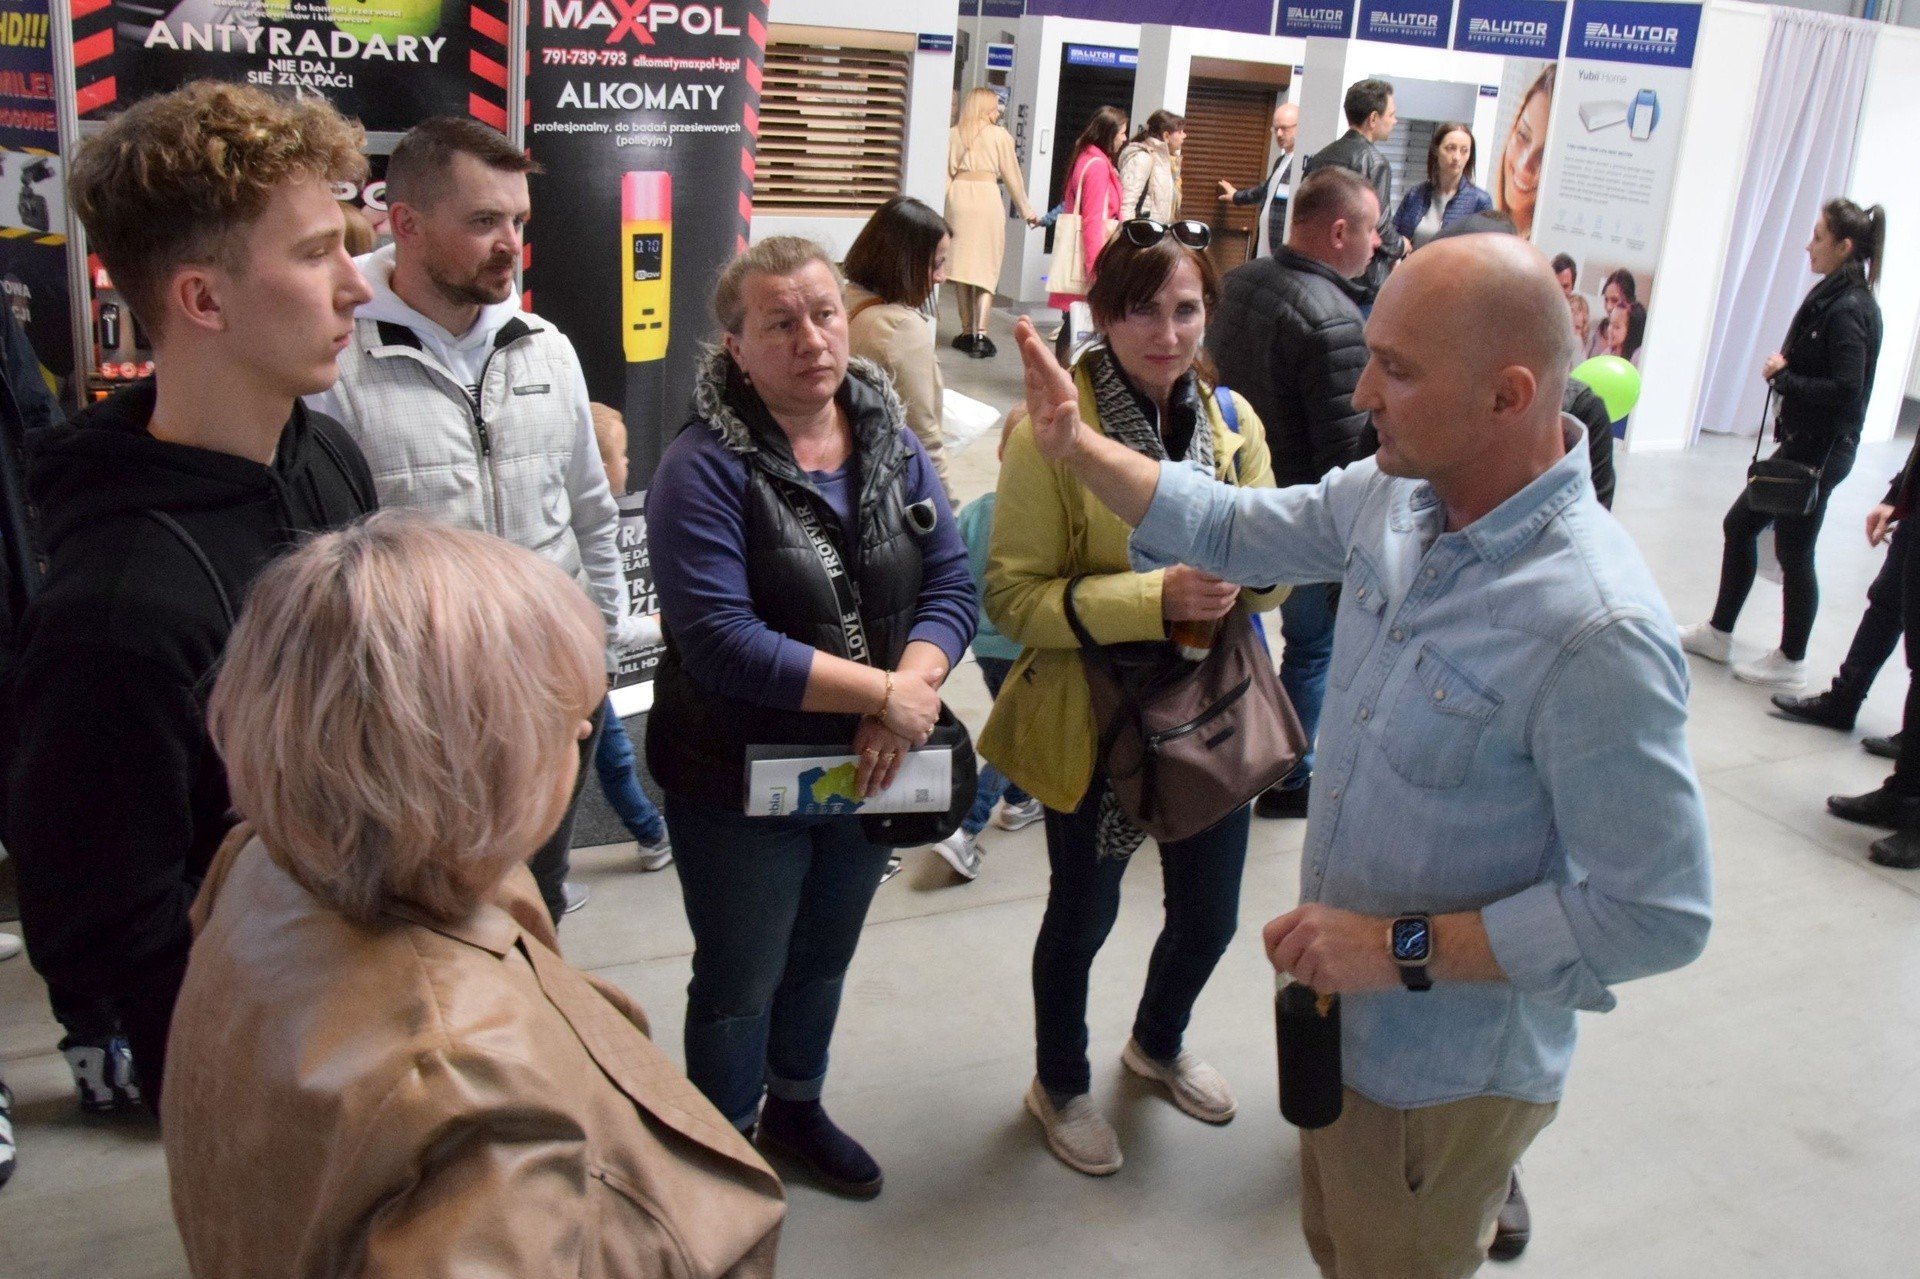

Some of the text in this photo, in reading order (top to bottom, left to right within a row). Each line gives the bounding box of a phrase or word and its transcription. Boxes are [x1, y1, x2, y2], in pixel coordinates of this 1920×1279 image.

[1295, 7, 1344, 21] ALUTOR
[1380, 11, 1438, 28] ALUTOR
[1480, 18, 1548, 36] ALUTOR
[1597, 22, 1679, 43] ALUTOR
[144, 20, 447, 63] ANTYRADARY
[542, 49, 627, 67] 791-739-793
[1078, 48, 1116, 59] ALUTOR
[268, 59, 336, 75] NIE DAJ
[247, 70, 354, 88] SIĘ ZŁAPAĆ!
[556, 81, 725, 111] ALKOMATY
[533, 120, 741, 137] profesjonalny, do badań przesiewowych
[616, 135, 673, 147] (policyjny)
[843, 611, 867, 661] LOVE
